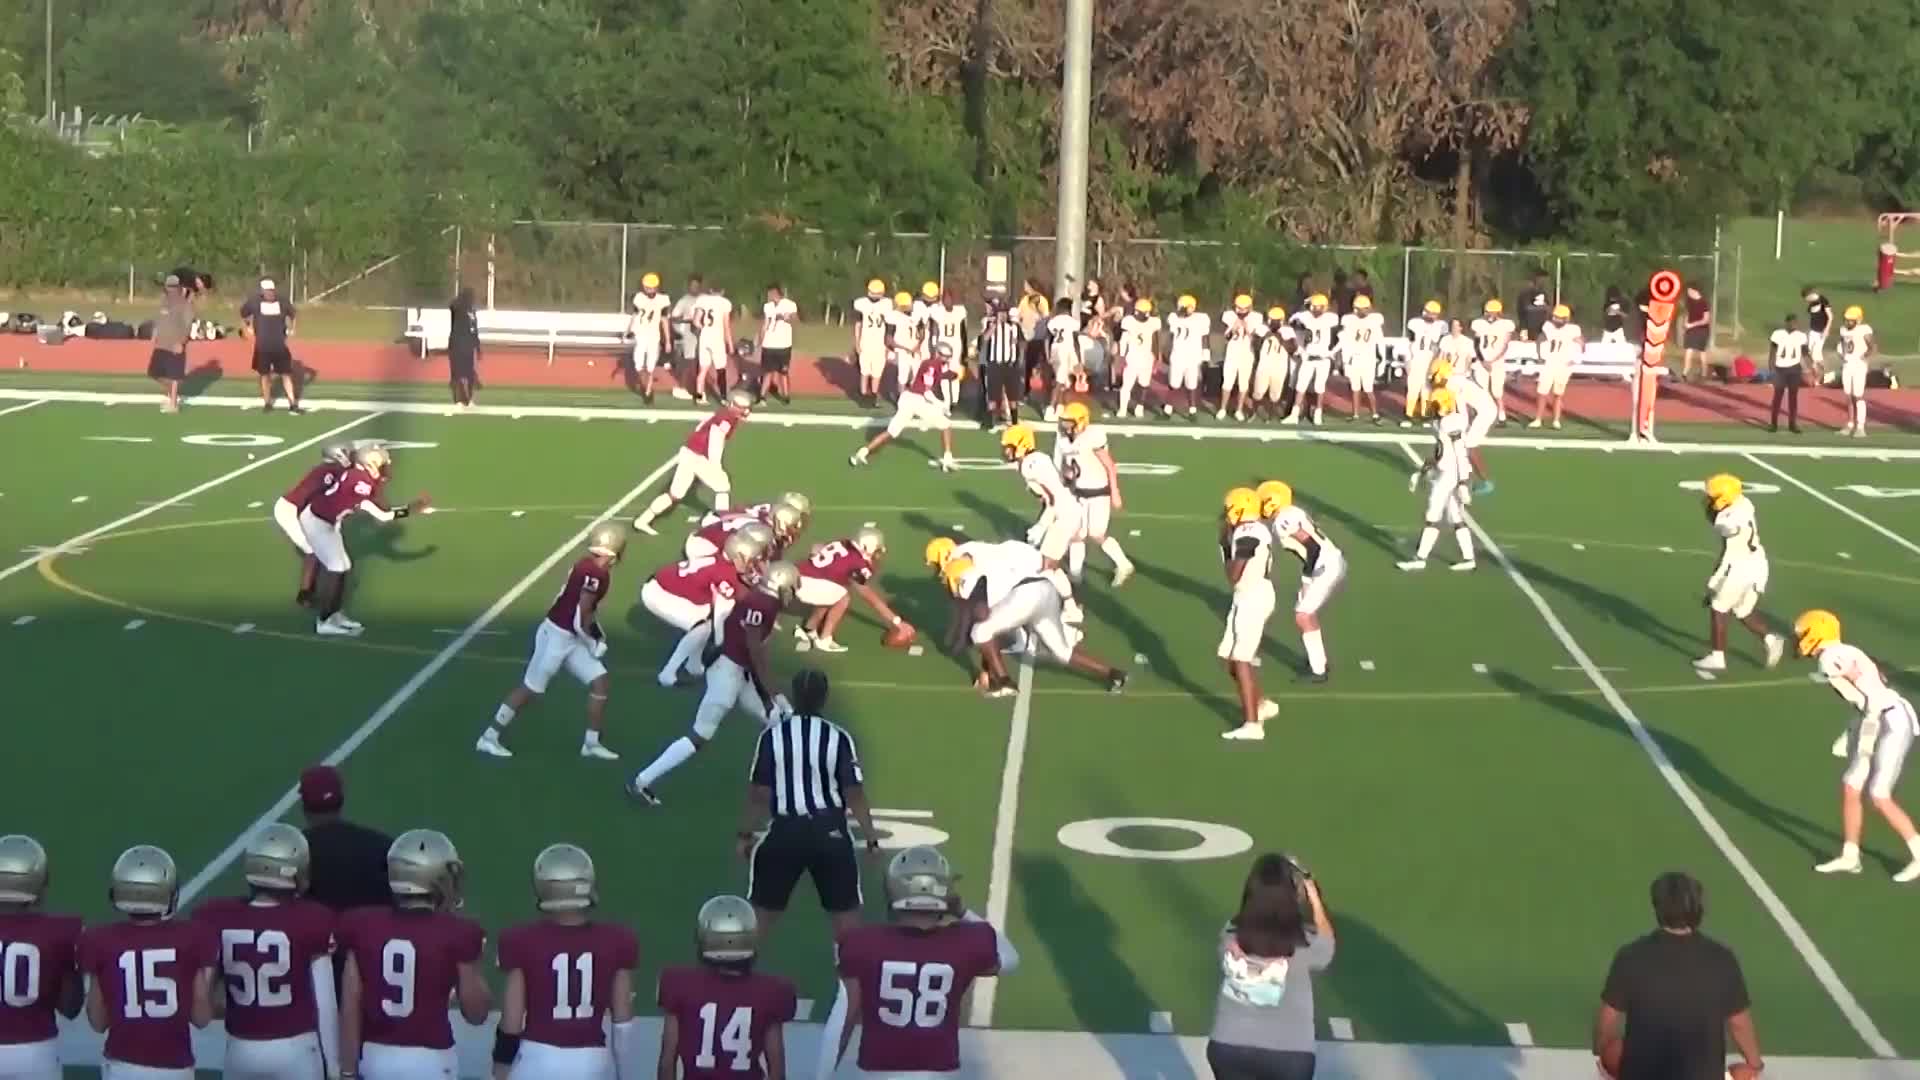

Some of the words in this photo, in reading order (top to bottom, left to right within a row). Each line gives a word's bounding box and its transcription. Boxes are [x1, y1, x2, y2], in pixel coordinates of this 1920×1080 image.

[745, 607, 763, 627] 10
[1057, 817, 1253, 860] 0
[0, 941, 41, 1007] 0
[119, 949, 178, 1018] 15
[221, 929, 292, 1007] 52
[381, 939, 416, 1018] 9
[552, 951, 593, 1019] 11
[878, 961, 954, 1028] 58
[695, 1002, 753, 1071] 14
